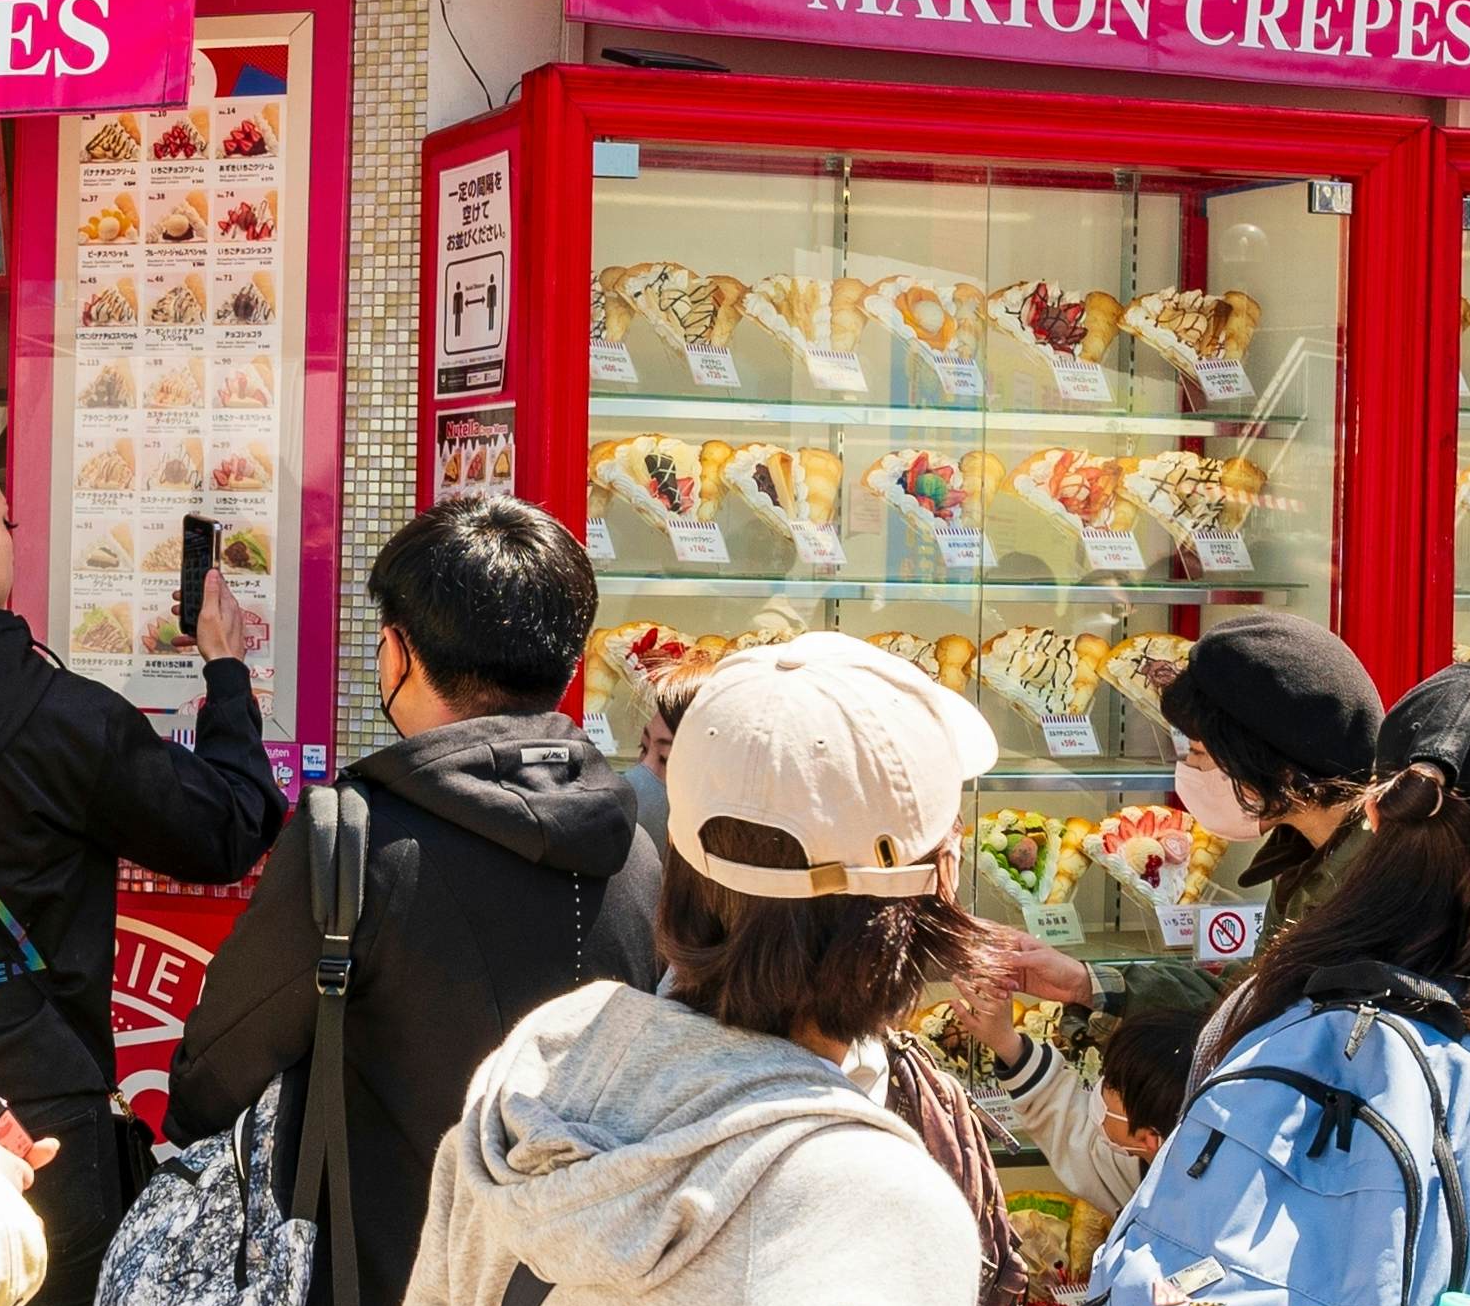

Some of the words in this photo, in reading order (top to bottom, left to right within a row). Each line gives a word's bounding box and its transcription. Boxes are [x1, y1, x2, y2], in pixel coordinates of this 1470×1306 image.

[448, 171, 502, 203] 一定の間隔を
[462, 200, 490, 226] 空けて
[446, 419, 479, 438] Nutella
